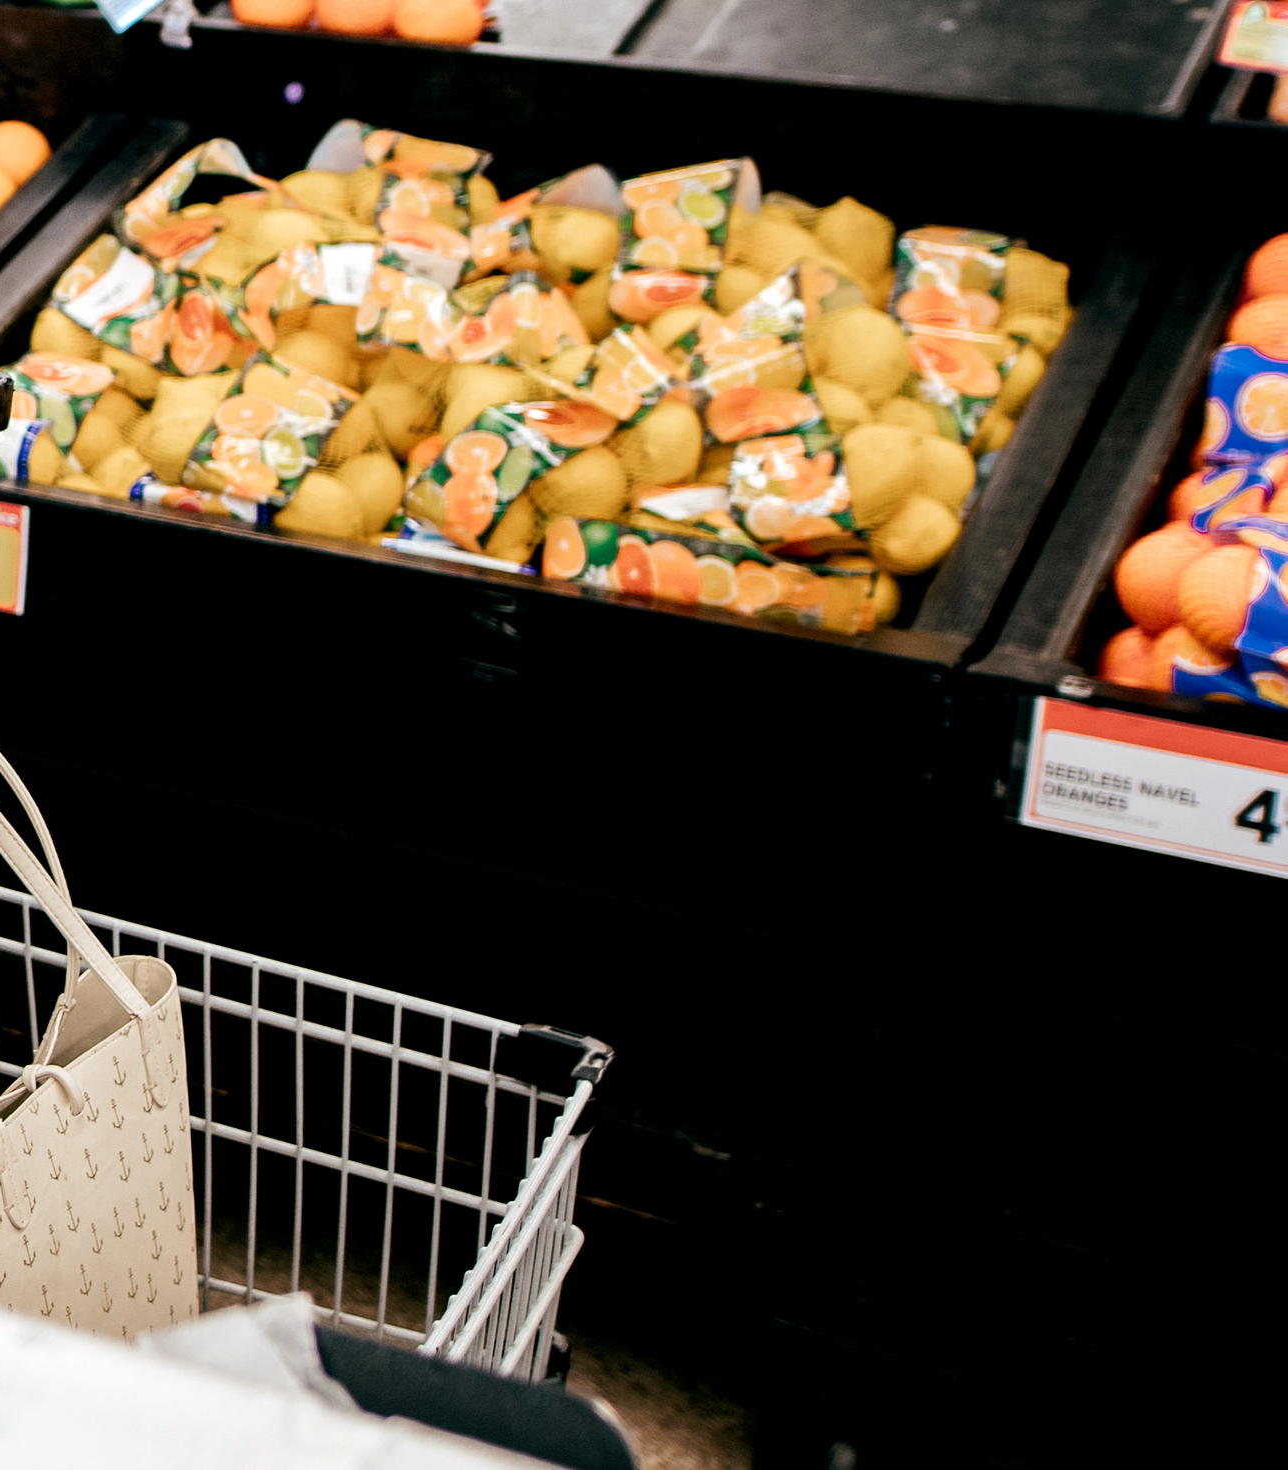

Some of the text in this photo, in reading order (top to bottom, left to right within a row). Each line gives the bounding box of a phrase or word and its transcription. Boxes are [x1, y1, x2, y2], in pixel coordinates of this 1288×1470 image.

[1042, 780, 1129, 812] ORANGES
[1044, 761, 1200, 808] SEEDLESS NAVEL
